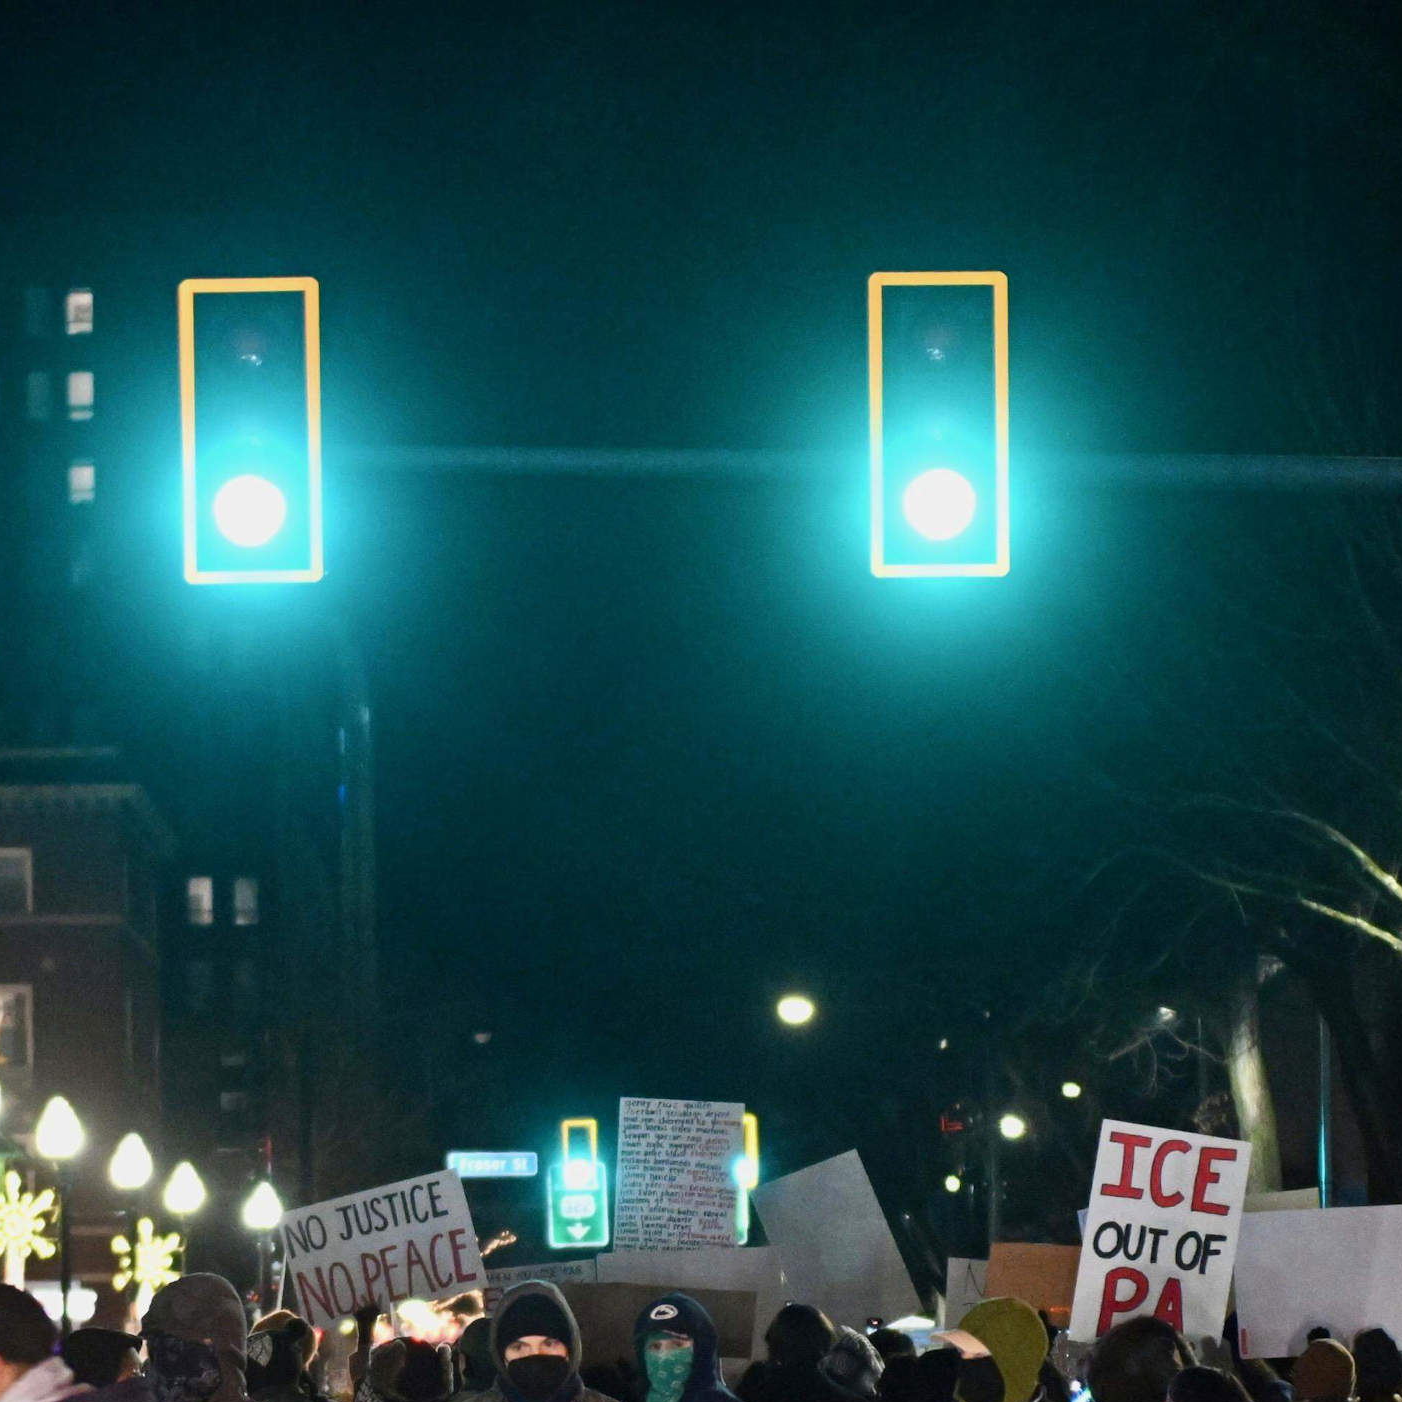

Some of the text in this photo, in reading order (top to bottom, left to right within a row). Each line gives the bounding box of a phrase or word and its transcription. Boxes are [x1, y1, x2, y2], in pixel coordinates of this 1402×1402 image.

[1100, 1131, 1237, 1216] ICE
[284, 1180, 448, 1259] NO JUSTICE
[1093, 1221, 1227, 1274] OUT OF
[296, 1228, 477, 1326] NO PEACE
[1096, 1267, 1184, 1338] PA
